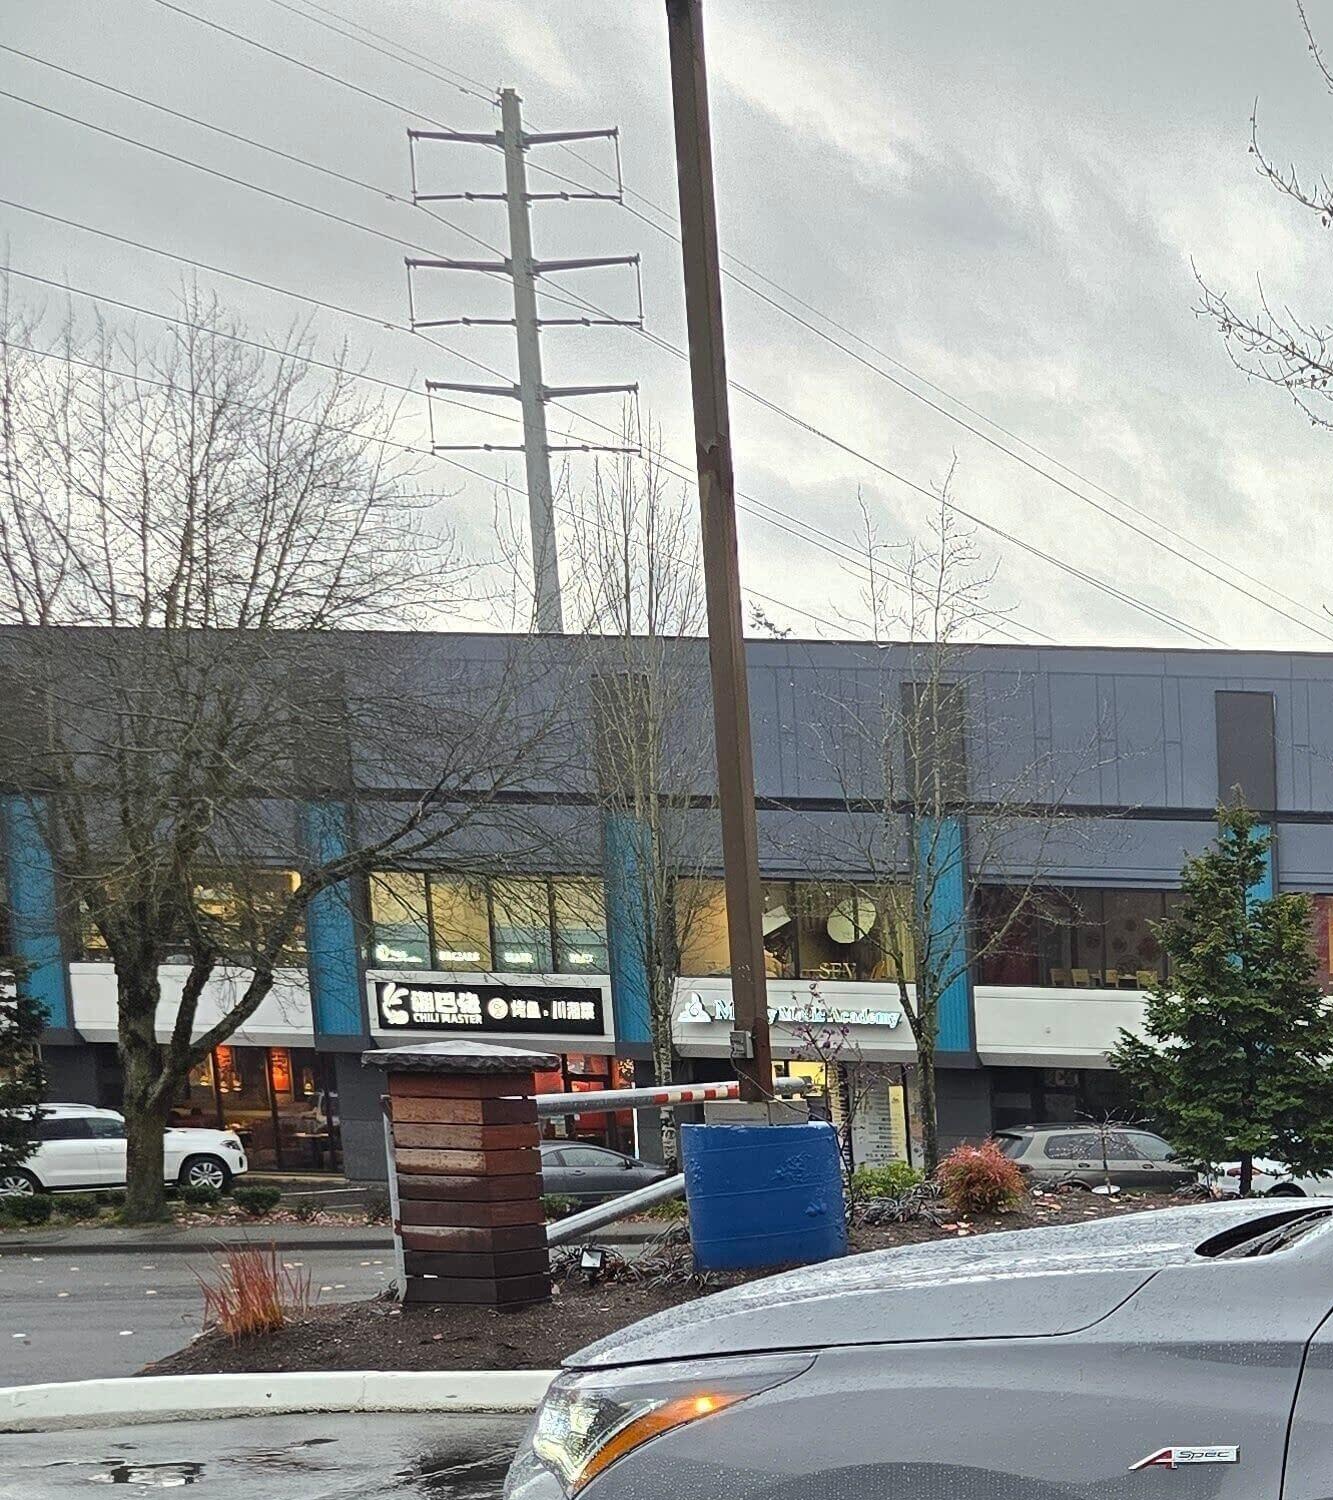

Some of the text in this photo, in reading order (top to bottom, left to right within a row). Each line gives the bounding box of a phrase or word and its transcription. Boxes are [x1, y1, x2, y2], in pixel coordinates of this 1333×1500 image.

[412, 1012, 483, 1025] CHILI MASTER
[827, 1007, 902, 1029] Academy
[1178, 1450, 1230, 1460] Spec
